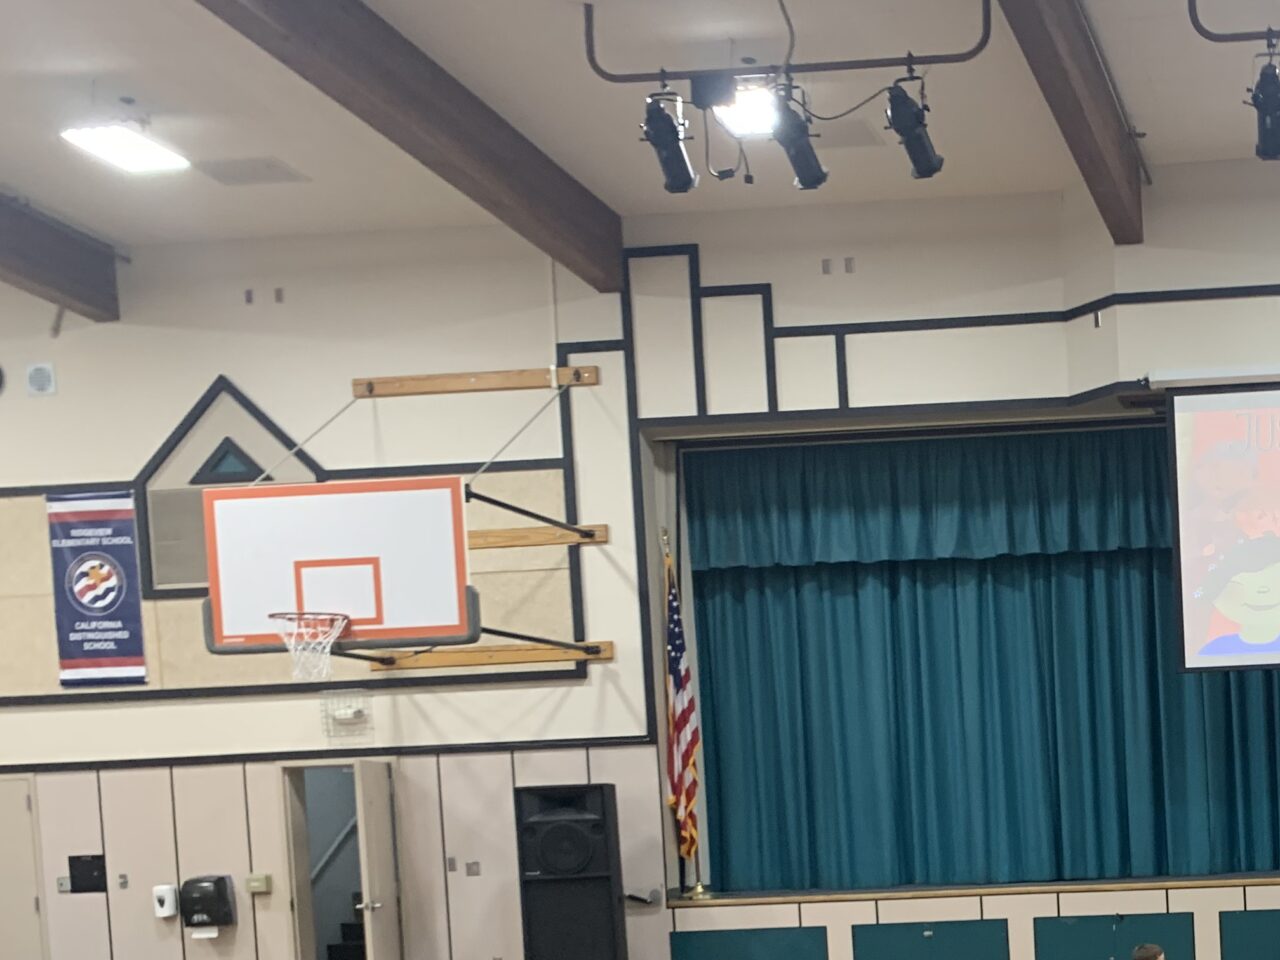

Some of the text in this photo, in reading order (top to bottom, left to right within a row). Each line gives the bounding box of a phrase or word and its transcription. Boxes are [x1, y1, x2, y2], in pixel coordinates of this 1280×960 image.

[52, 536, 134, 547] ELEMENTARY SCHOOL
[74, 620, 123, 630] CALIFORNIA
[68, 630, 130, 641] DISTINGUISHED
[83, 641, 117, 651] SCHOOL
